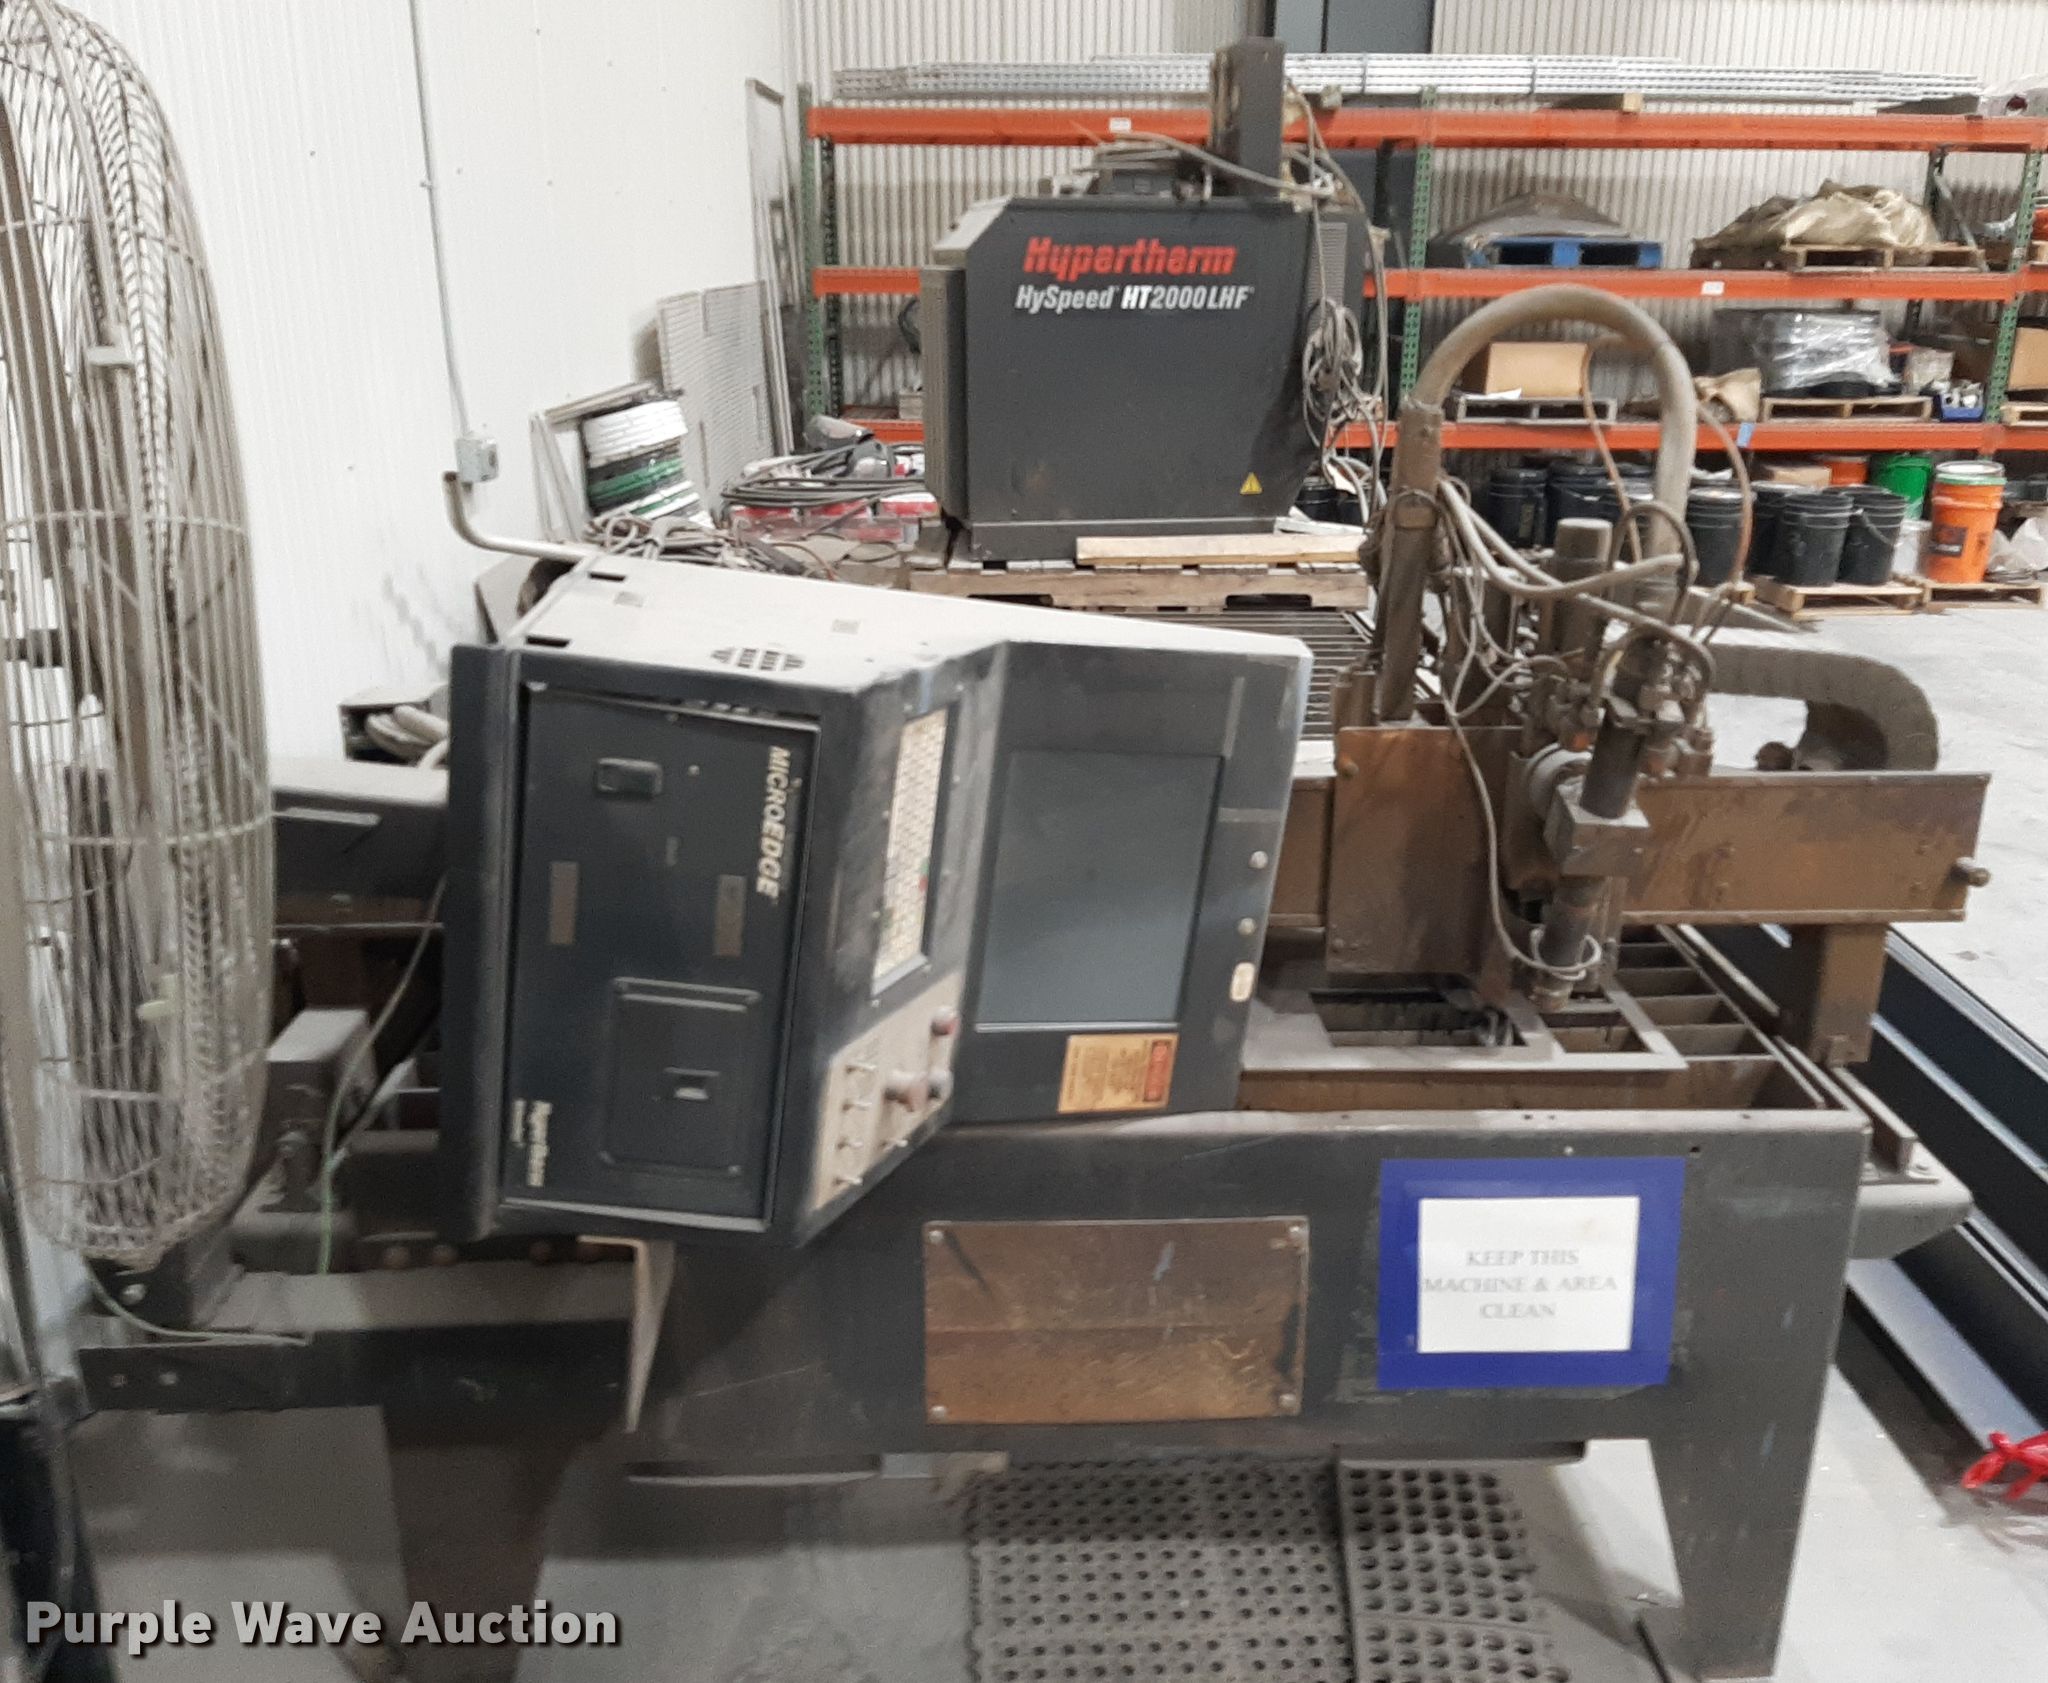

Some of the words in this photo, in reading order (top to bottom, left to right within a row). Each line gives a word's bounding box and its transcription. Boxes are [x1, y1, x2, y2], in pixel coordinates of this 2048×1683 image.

[1023, 236, 1236, 282] Hypertherm
[1015, 284, 1114, 314] HySpeed
[756, 746, 791, 897] MICROEDGE
[1466, 1250, 1523, 1266] KEEP
[1530, 1250, 1579, 1265] THIS
[1424, 1277, 1525, 1293] MACHINE
[1532, 1277, 1549, 1292] &
[1559, 1276, 1618, 1292] AREA
[1480, 1303, 1556, 1319] CLEAN
